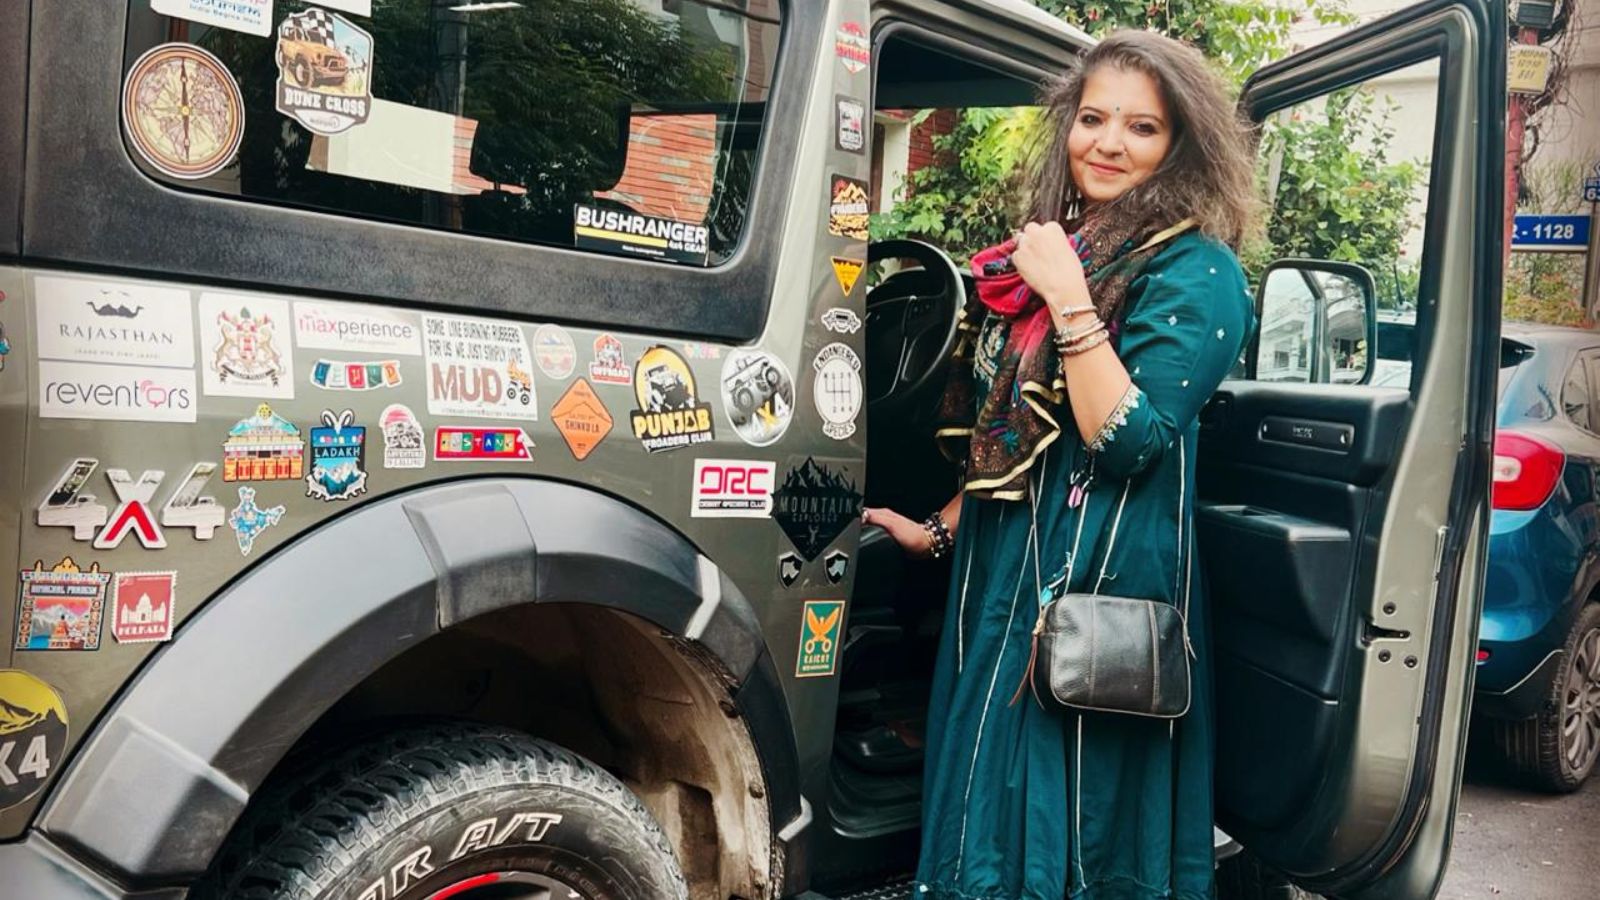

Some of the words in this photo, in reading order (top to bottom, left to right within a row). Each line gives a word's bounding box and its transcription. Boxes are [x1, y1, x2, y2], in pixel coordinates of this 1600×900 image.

[284, 87, 321, 108] DUNE
[325, 96, 366, 117] CROSS
[577, 206, 707, 244] BUSHRANGER
[1533, 224, 1574, 239] 1128
[684, 242, 707, 254] GEAR
[59, 324, 173, 344] RAJASTHAN
[299, 312, 412, 340] maxperience
[426, 318, 445, 336] SOME
[492, 324, 520, 343] RUBBERS
[428, 339, 442, 357] FOR
[815, 345, 859, 370] ENDANGERED
[46, 380, 190, 409] reventors
[431, 363, 502, 404] MUD
[633, 408, 711, 439] PUNJAB
[825, 423, 854, 438] SPECIES
[690, 431, 712, 443] CLUB
[315, 447, 360, 458] LADAKH
[780, 496, 853, 513] MOUNTAIN
[118, 624, 166, 636] KOLKATA
[450, 812, 562, 861] A/T
